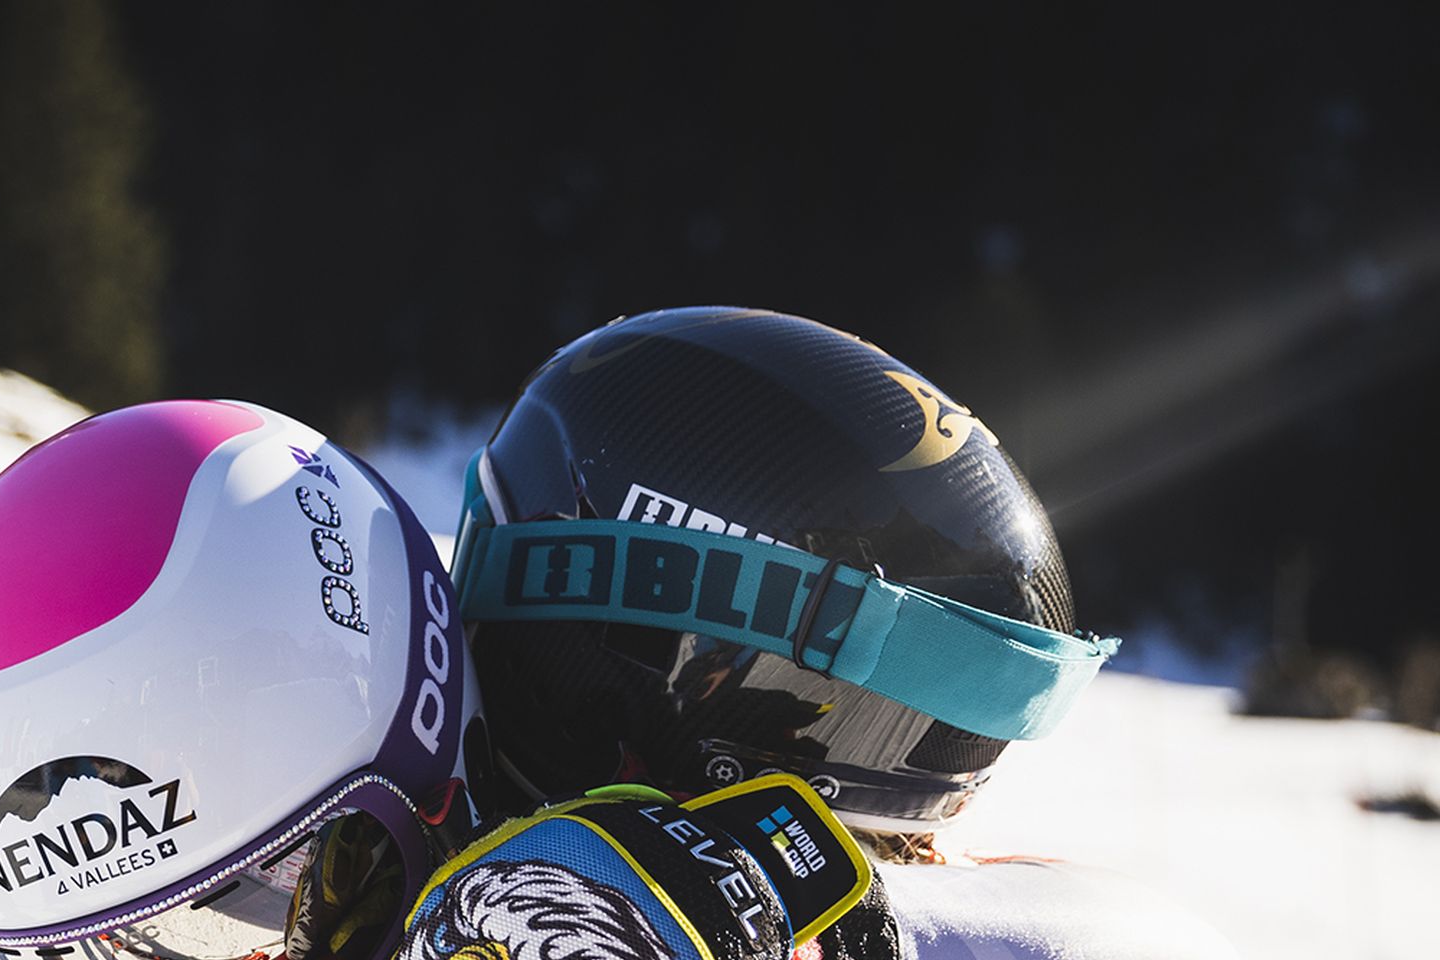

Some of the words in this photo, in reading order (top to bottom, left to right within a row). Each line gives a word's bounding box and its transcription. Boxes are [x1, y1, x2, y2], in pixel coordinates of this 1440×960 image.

[295, 485, 370, 636] POC
[622, 535, 866, 655] BLIZ
[411, 570, 450, 755] POC
[71, 849, 156, 890] VALLEES
[638, 806, 763, 940] LEVEL
[784, 820, 827, 873] WORLD
[786, 849, 810, 879] CUP
